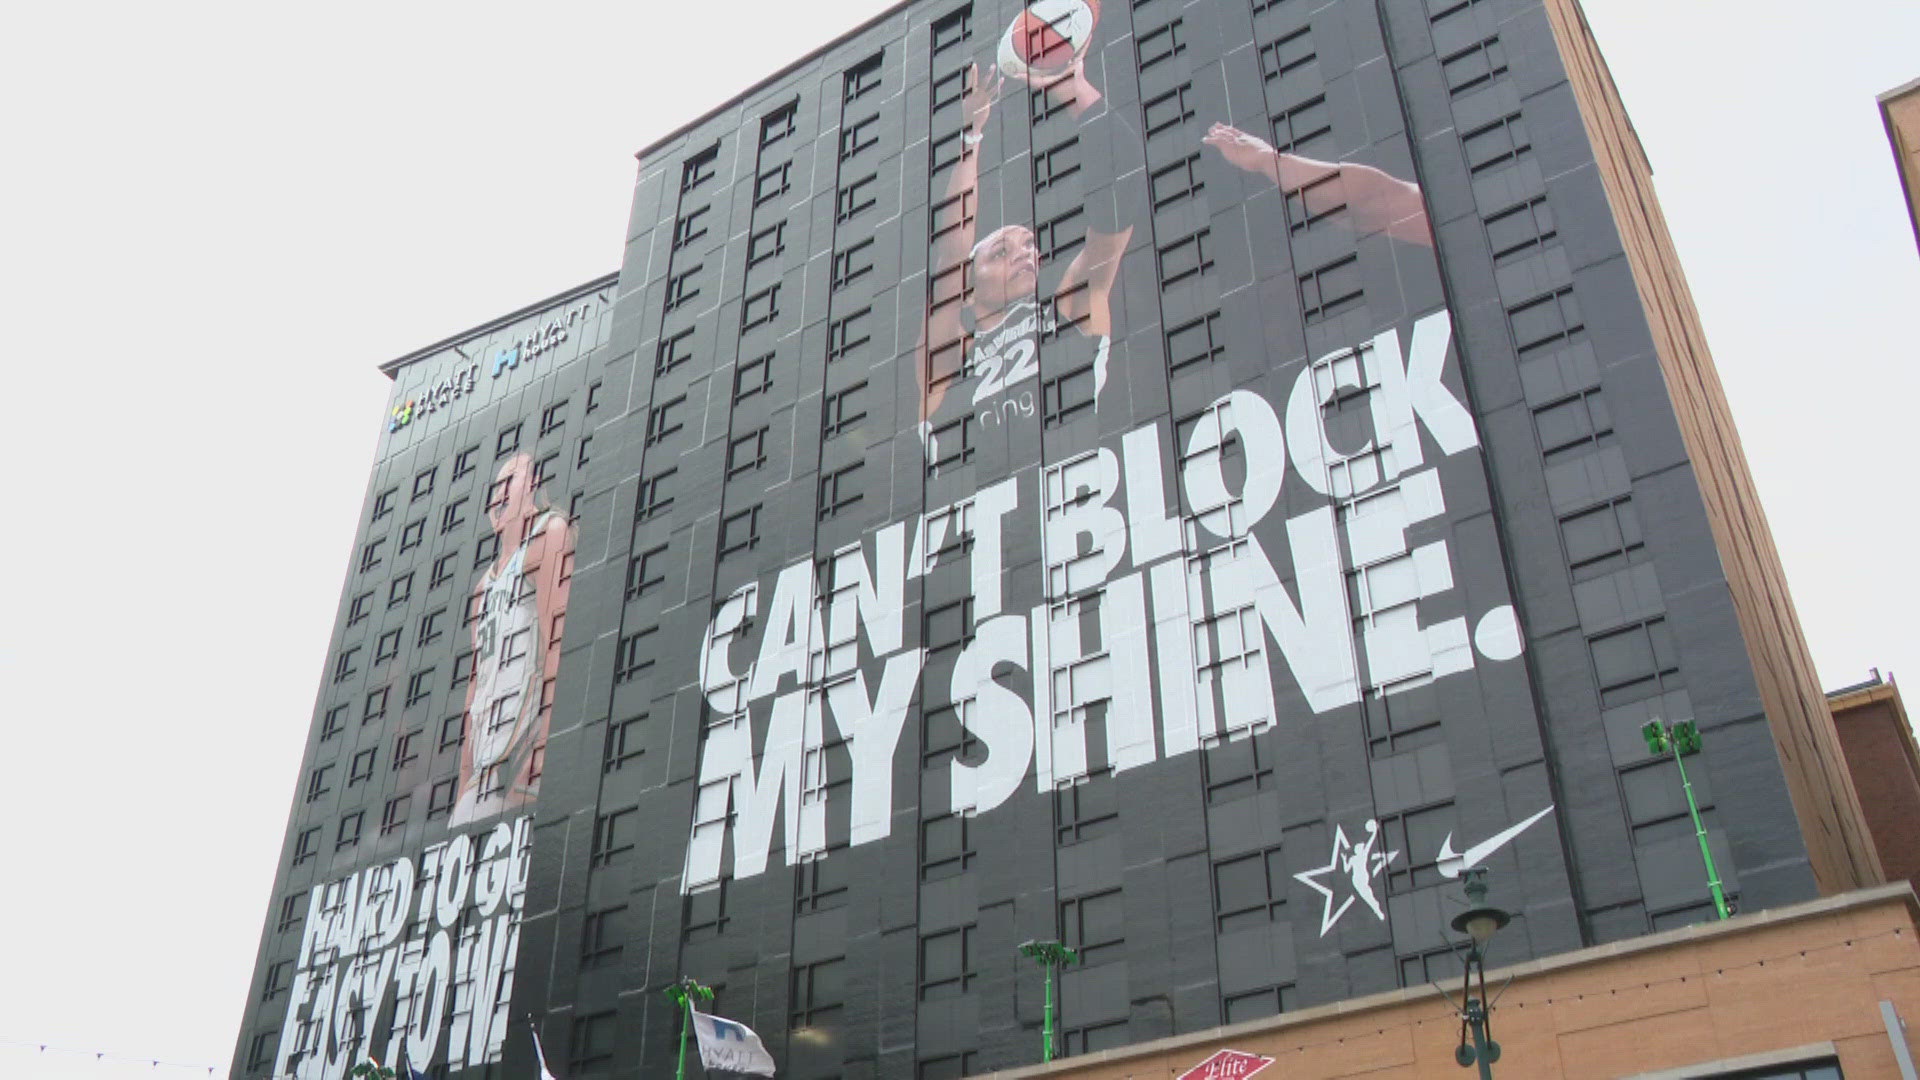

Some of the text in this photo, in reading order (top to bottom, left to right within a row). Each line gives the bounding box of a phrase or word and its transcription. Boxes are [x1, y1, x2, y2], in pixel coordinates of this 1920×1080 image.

[524, 304, 589, 348] HYATT
[417, 380, 474, 419] PLACE
[419, 363, 477, 403] HYATT
[972, 339, 1039, 405] 22
[700, 309, 1480, 714] CAN'T BLOCK
[680, 467, 1525, 895] MY SHINE.
[297, 857, 414, 970] HARD
[418, 834, 475, 934] TO
[1205, 1052, 1248, 1079] Elite
